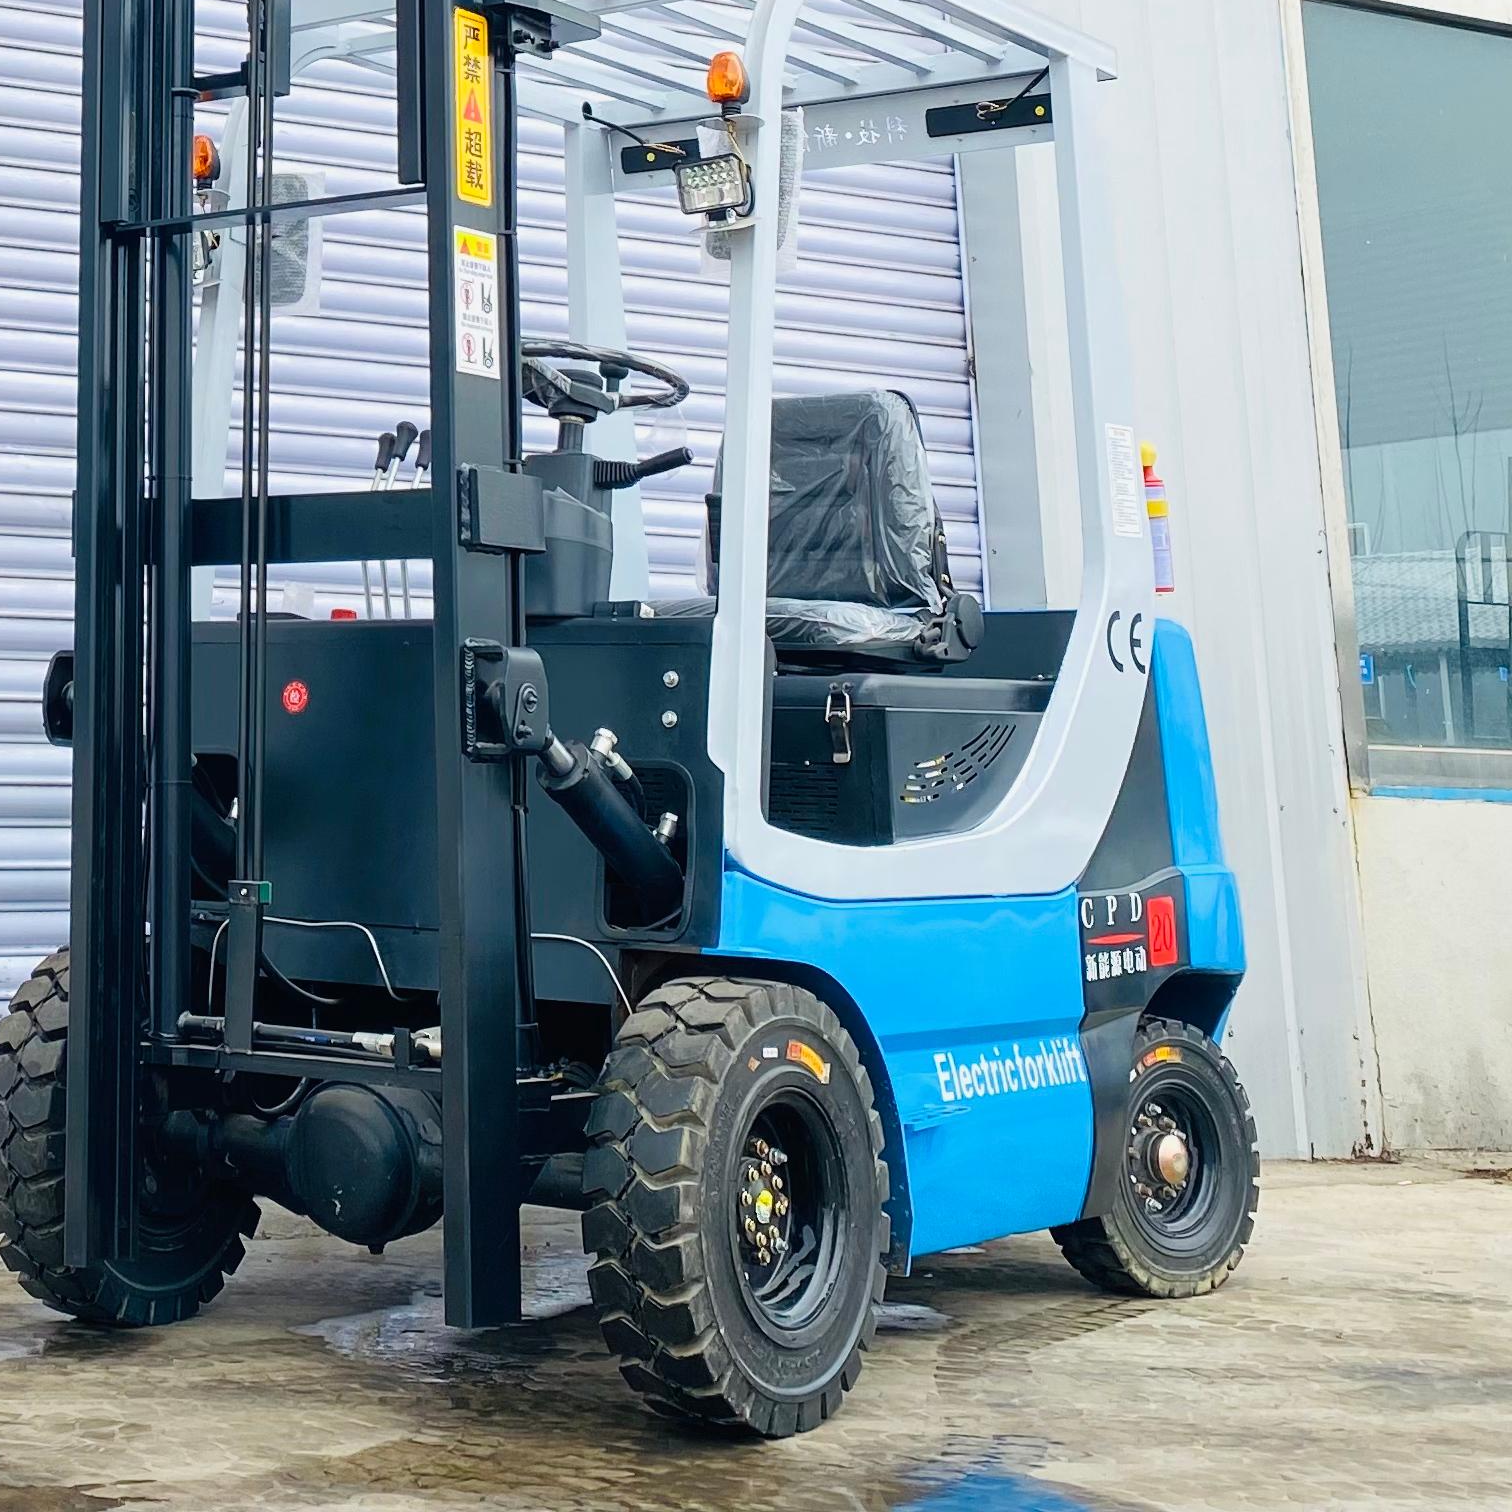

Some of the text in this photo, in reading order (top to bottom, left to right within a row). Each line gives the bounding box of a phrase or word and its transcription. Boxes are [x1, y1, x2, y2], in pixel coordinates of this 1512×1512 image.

[463, 24, 484, 191] 严禁 超载
[1106, 610, 1146, 675] CE
[1151, 913, 1173, 952] 20
[1085, 945, 1147, 981] 新能源电动
